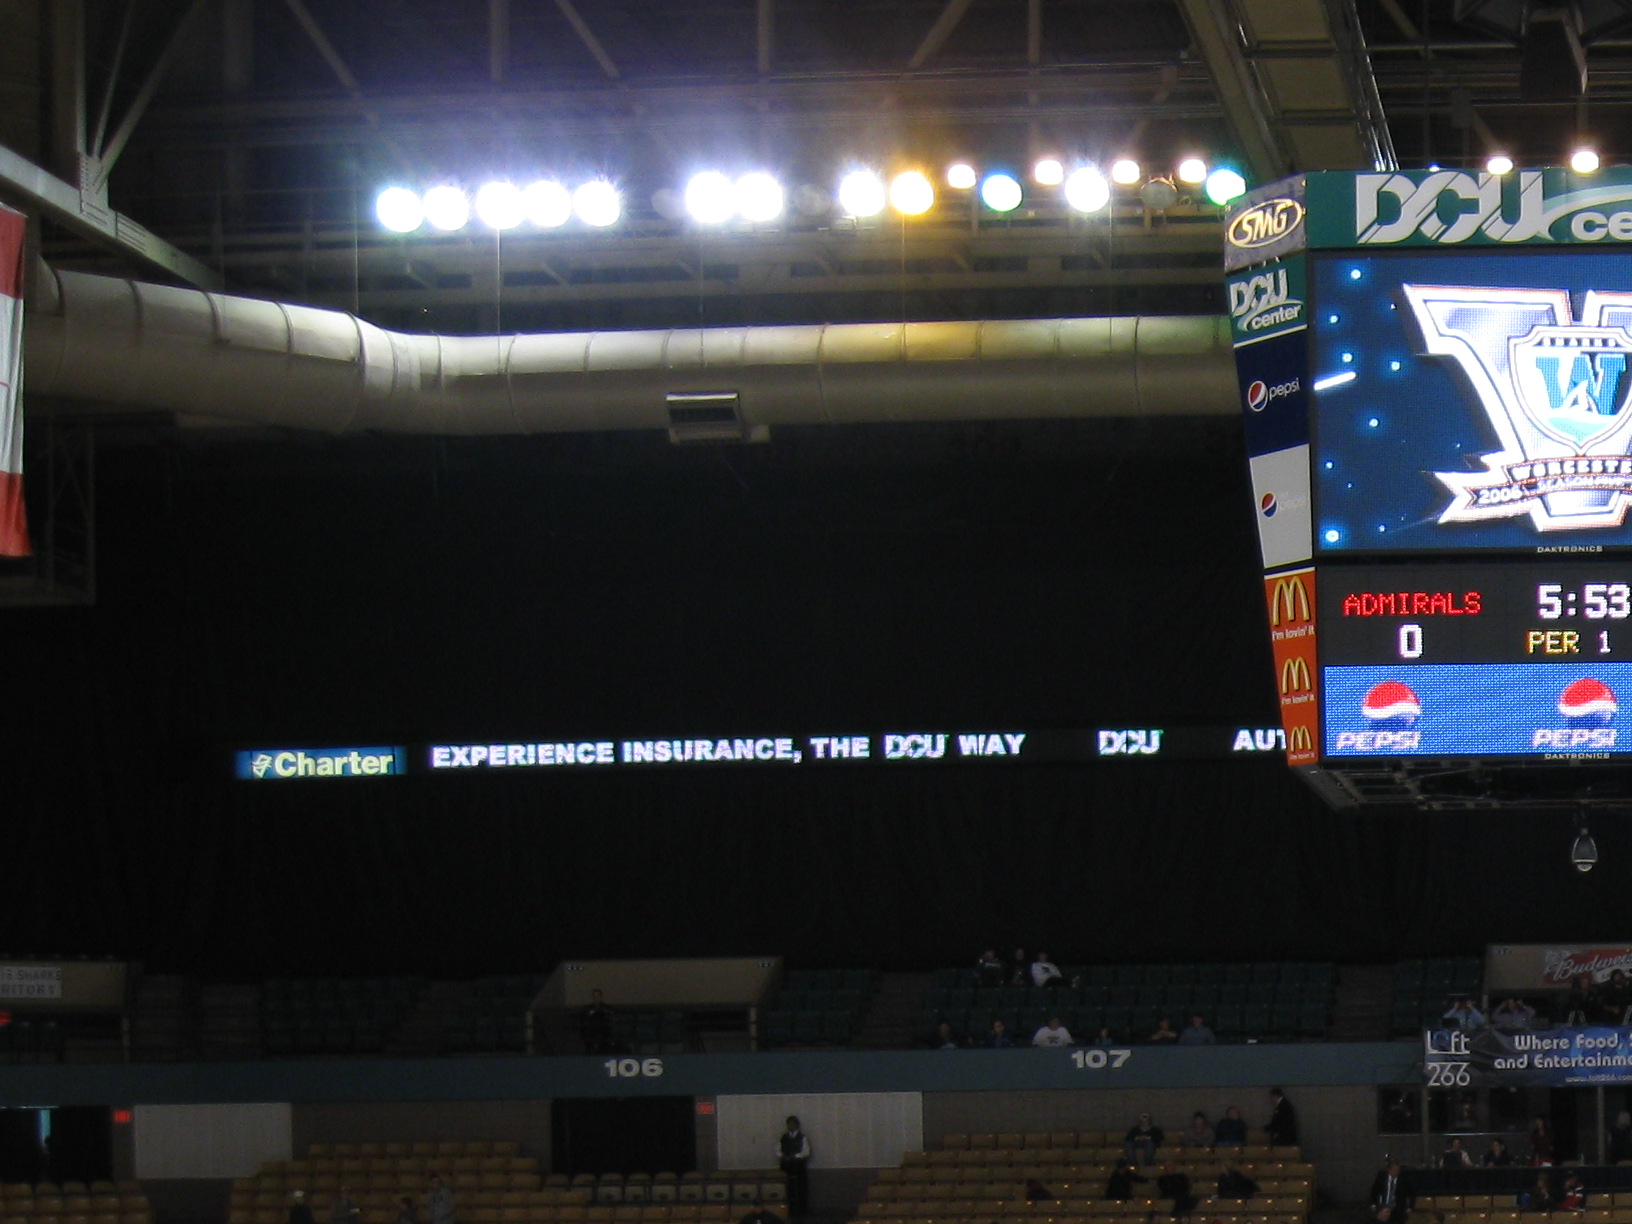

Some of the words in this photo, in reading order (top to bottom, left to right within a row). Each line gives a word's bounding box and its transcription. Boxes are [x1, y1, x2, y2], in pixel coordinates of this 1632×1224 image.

[1356, 171, 1548, 244] DCU
[1238, 202, 1293, 243] SMG
[1230, 269, 1288, 317] DCU
[1251, 305, 1301, 330] center
[1269, 378, 1300, 400] pepsi
[1479, 486, 1523, 504] 2006
[1537, 545, 1603, 553] DAKTRONICS
[1342, 591, 1482, 617] ADMIRALS
[1537, 583, 1632, 619] 5:53
[1398, 623, 1423, 658] 0
[1526, 630, 1580, 654] PER
[1599, 630, 1612, 654] 1
[1099, 729, 1163, 754] DCU
[1336, 730, 1421, 750] PEPSI
[1531, 728, 1617, 748] PEPSI
[432, 741, 615, 768] EXPERIENCE
[623, 738, 801, 763] INSURANCE,
[811, 737, 870, 758] THE
[885, 733, 949, 759] DCU
[958, 733, 1025, 756] WAY
[1544, 752, 1611, 760] DAKTRONICS
[275, 750, 394, 776] Charter
[1514, 1034, 1570, 1050] Where
[1576, 1033, 1622, 1050] Food,
[604, 1058, 664, 1078] 106
[1072, 1049, 1132, 1069] 107
[1494, 1054, 1528, 1069] and
[1428, 1062, 1471, 1087] 266
